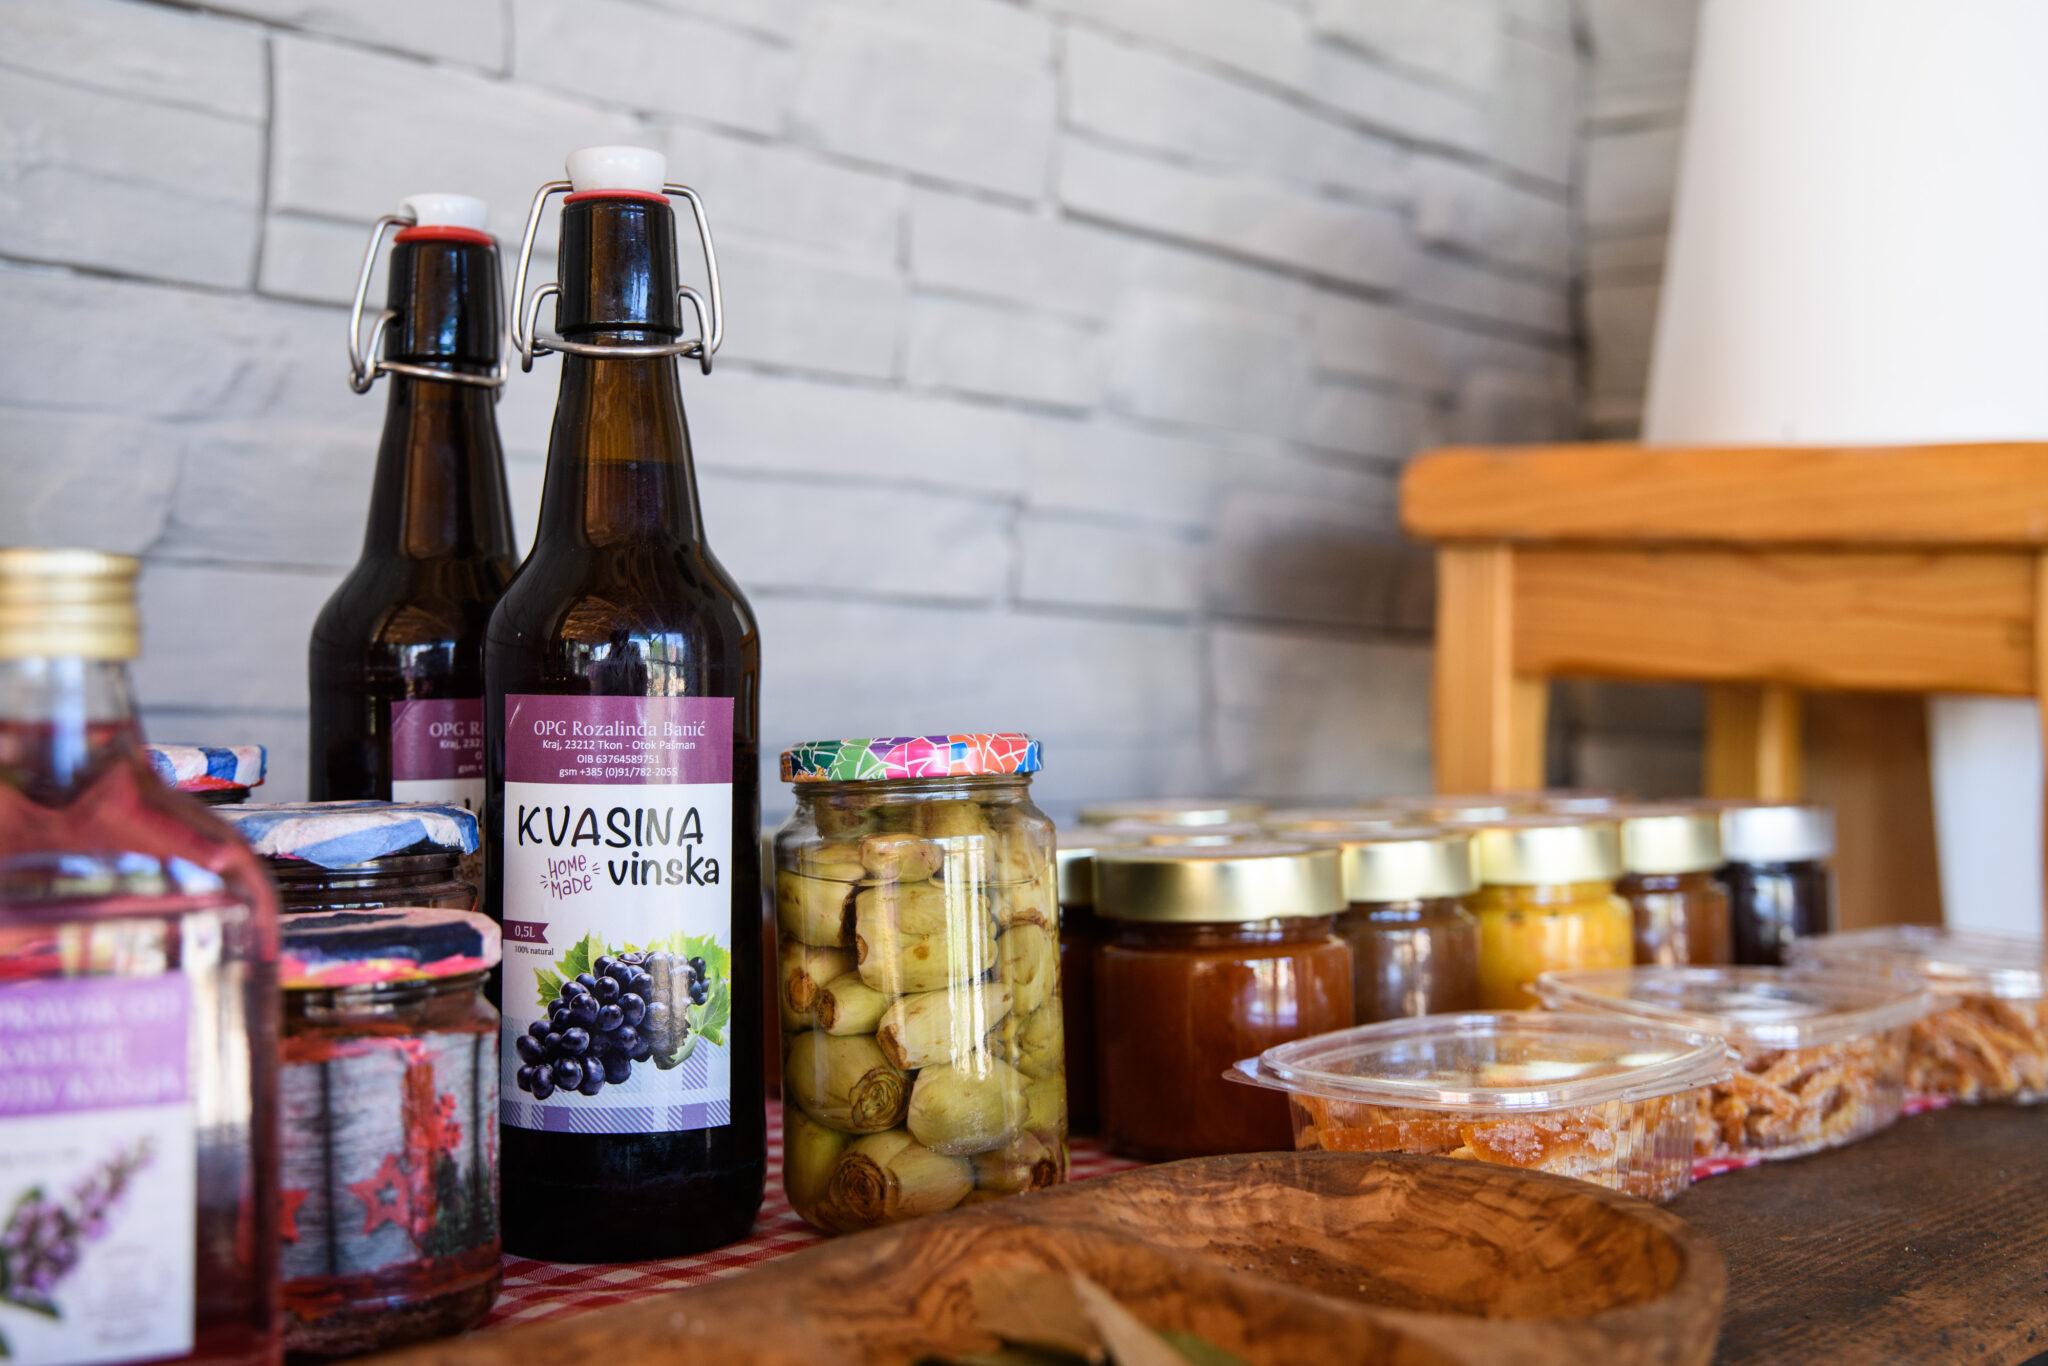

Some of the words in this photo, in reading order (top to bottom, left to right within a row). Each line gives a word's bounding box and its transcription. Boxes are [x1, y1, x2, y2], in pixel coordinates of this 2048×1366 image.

[429, 721, 465, 738] OPG
[533, 720, 567, 736] OPG
[572, 720, 657, 737] Rozalinda
[663, 720, 705, 737] Banić
[542, 739, 562, 751] Kraj,
[565, 740, 595, 750] 23212
[599, 740, 623, 750] Tkon
[632, 740, 656, 750] Otok
[659, 739, 696, 750] Pašman
[577, 754, 594, 764] OIB
[559, 769, 577, 777] gsm
[580, 767, 603, 777] +385
[518, 804, 704, 848] KVASINA
[608, 843, 720, 886] vinska
[514, 925, 536, 938] 0,5L
[515, 945, 529, 954] 100%
[530, 947, 554, 956] natural
